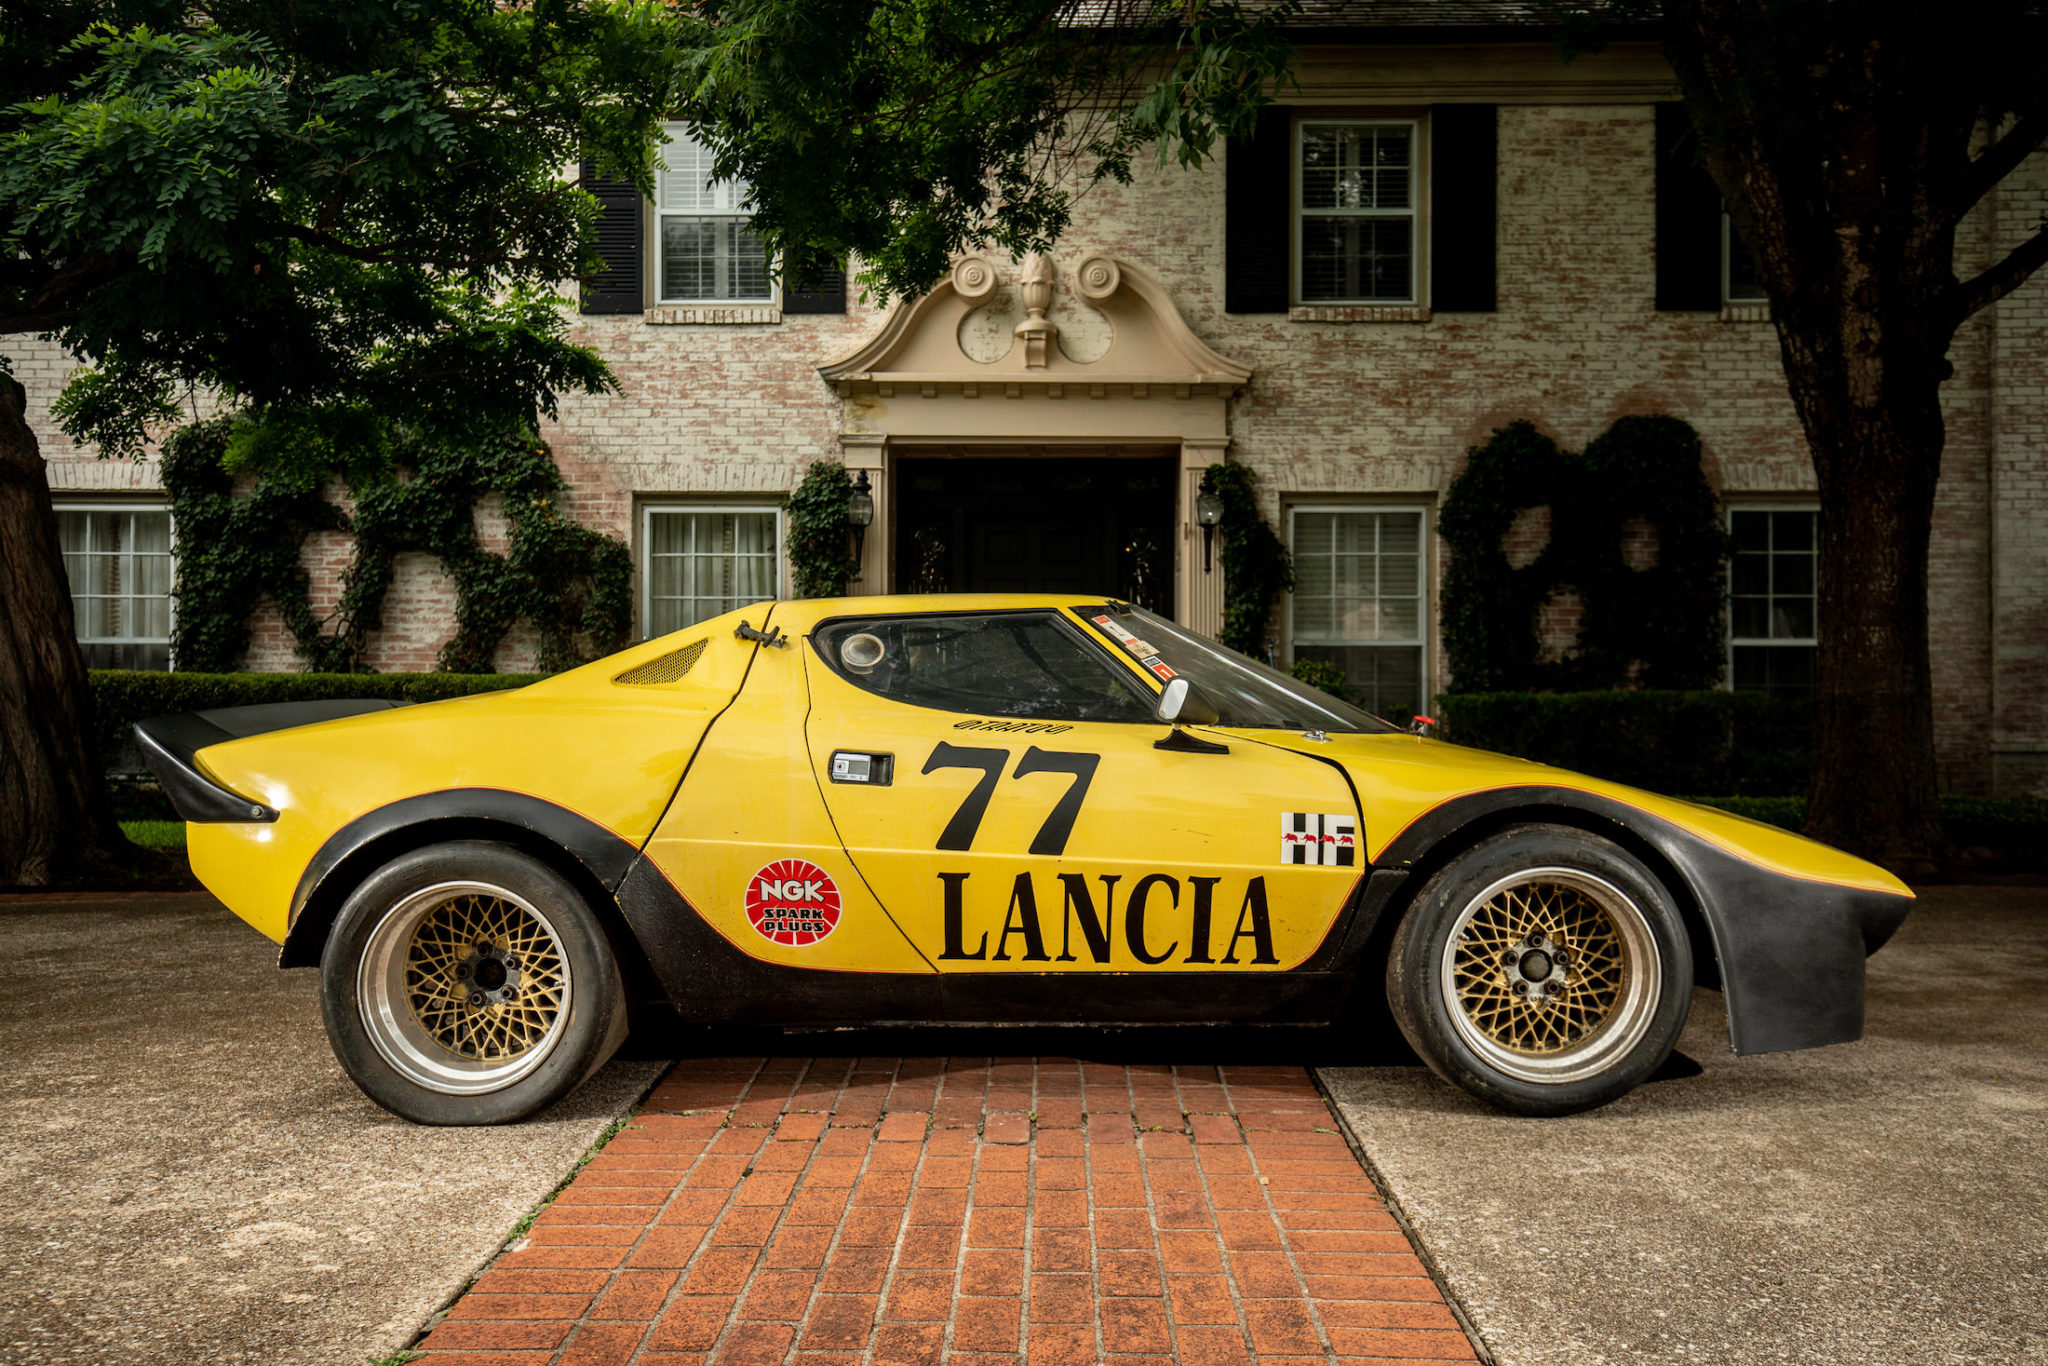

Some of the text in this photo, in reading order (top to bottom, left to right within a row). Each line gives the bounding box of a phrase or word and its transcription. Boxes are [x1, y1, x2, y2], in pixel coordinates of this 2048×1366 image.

[953, 720, 1075, 735] STRATOS
[921, 741, 1101, 856] 77
[1281, 812, 1355, 867] HF
[760, 879, 825, 903] NGK
[763, 908, 824, 920] SPARK
[936, 871, 1281, 965] LANCIA
[764, 921, 824, 932] PLUGS
